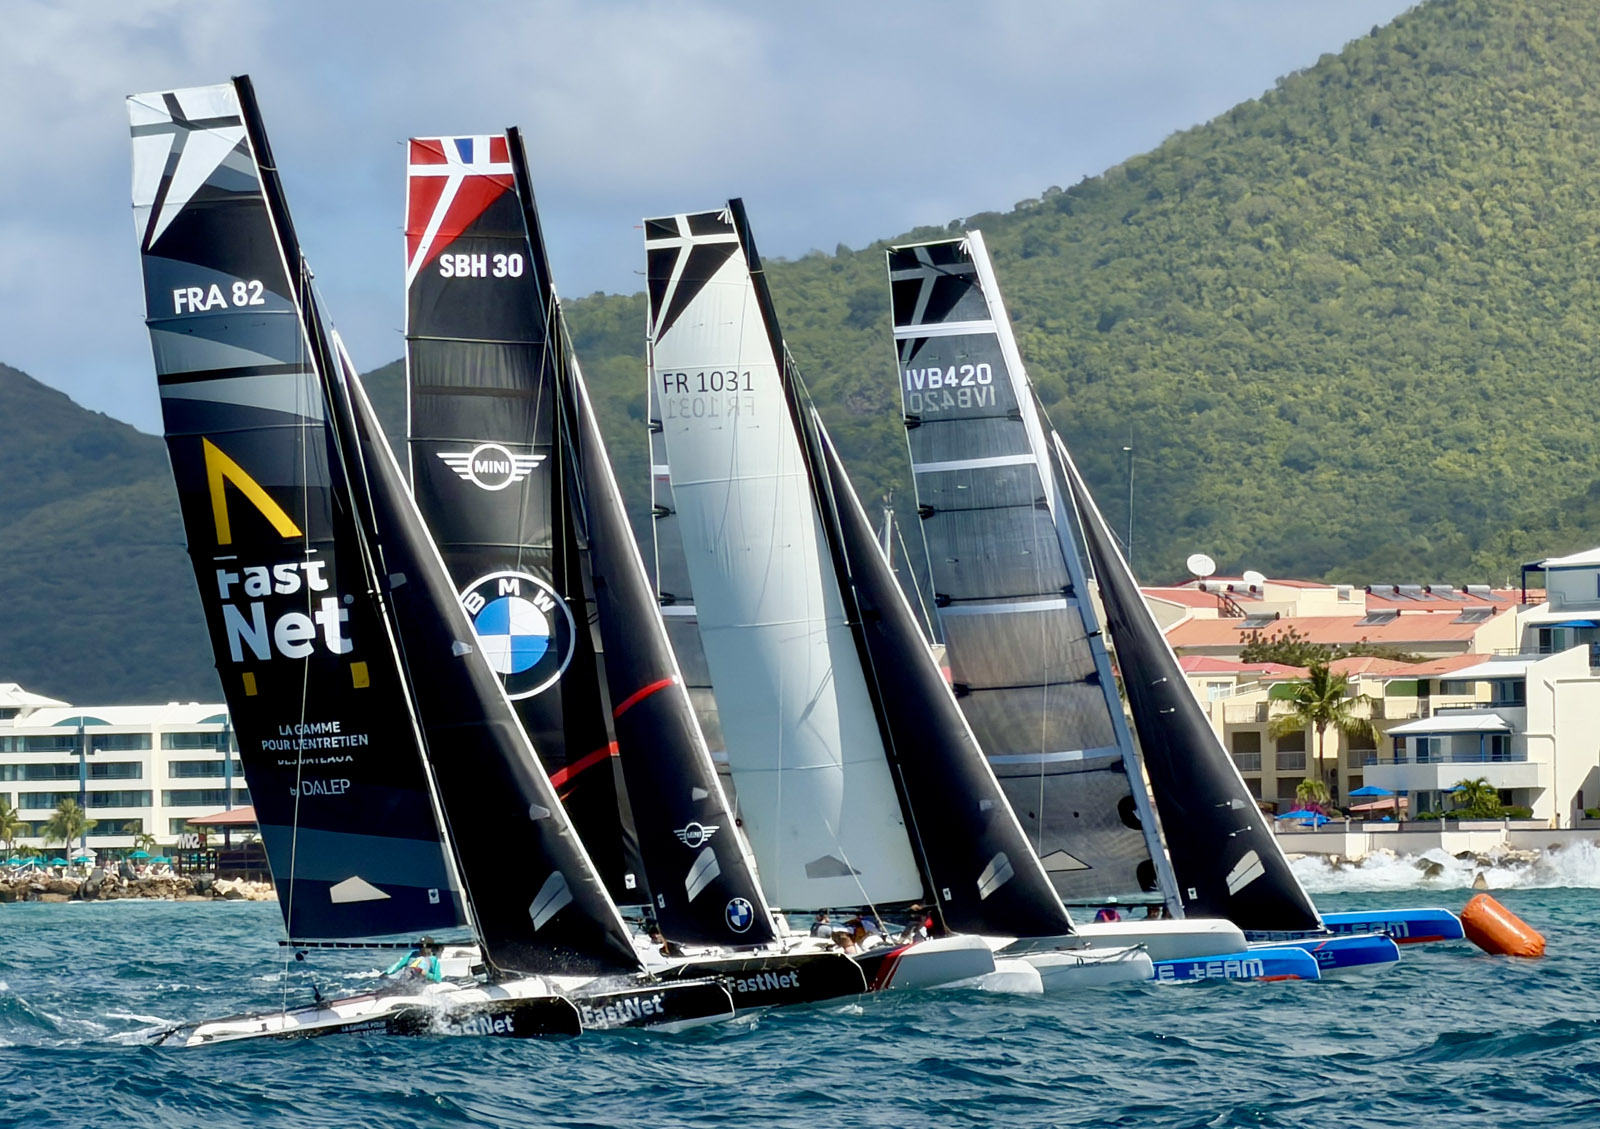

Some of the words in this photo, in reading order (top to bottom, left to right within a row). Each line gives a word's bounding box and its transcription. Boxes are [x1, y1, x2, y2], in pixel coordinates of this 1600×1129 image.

[440, 253, 487, 278] SBH
[492, 253, 523, 278] 30
[173, 284, 228, 314] FRA
[232, 280, 265, 307] 82
[663, 373, 689, 394] FR
[697, 371, 754, 392] 1031
[905, 363, 992, 391] IVB420
[474, 460, 510, 474] MINI
[213, 549, 329, 599] Fast
[463, 578, 556, 616] BMW
[222, 597, 354, 662] Net
[279, 725, 293, 735] LA
[294, 721, 341, 735] GAMME
[262, 739, 291, 751] POUR
[301, 779, 350, 795] DALEP
[725, 970, 799, 994] FastNet
[1153, 964, 1176, 981] E
